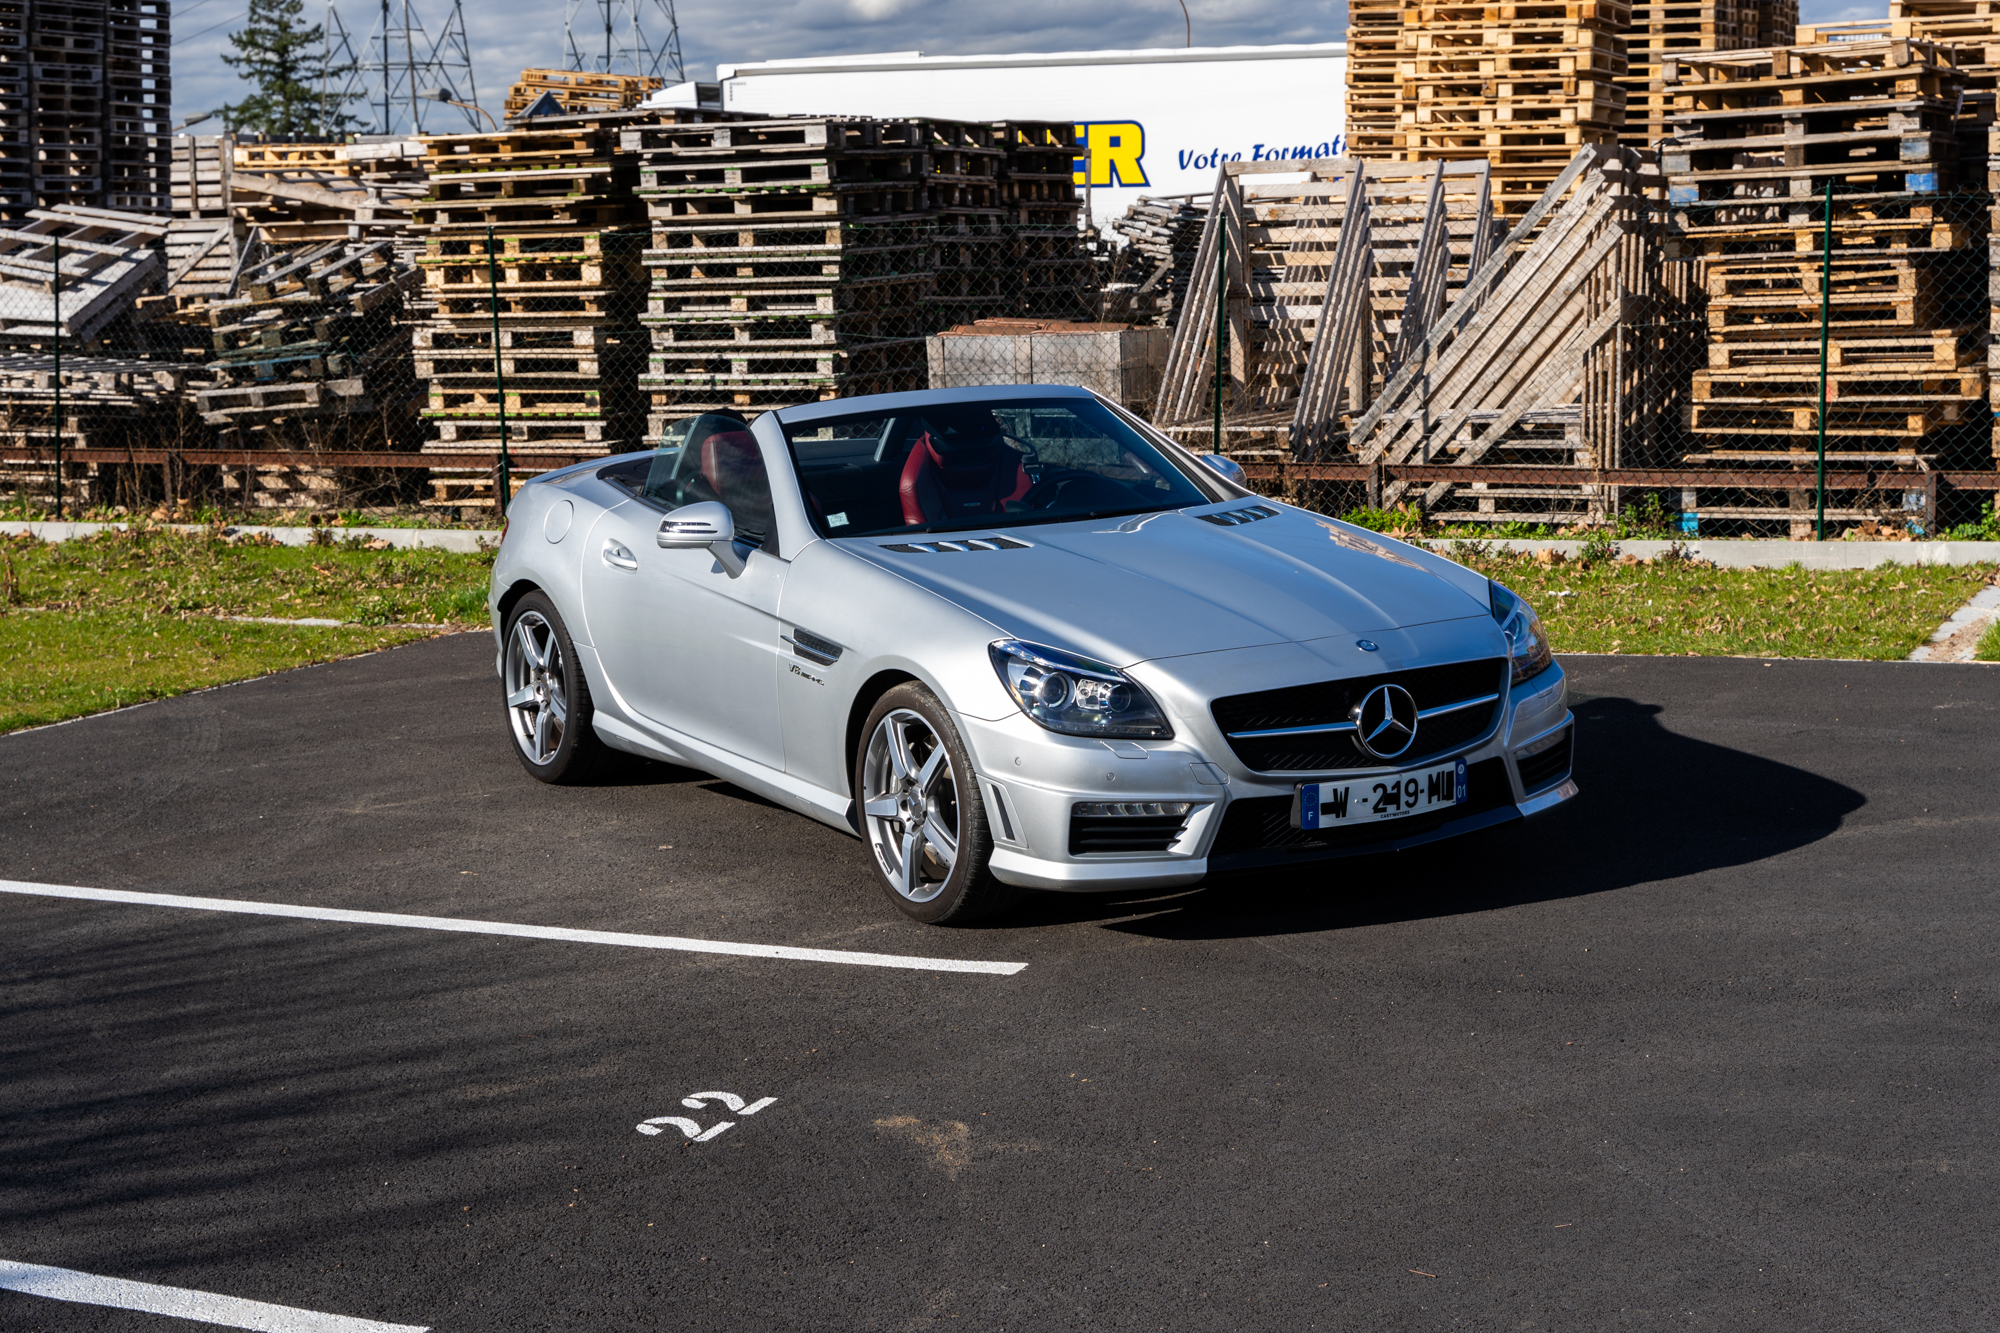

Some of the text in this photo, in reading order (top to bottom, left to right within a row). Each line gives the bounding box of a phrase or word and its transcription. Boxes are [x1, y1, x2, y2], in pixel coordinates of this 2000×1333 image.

[1178, 148, 1242, 170] Votre
[1457, 784, 1466, 799] 01
[1307, 811, 1314, 821] F
[635, 1091, 779, 1142] 22
